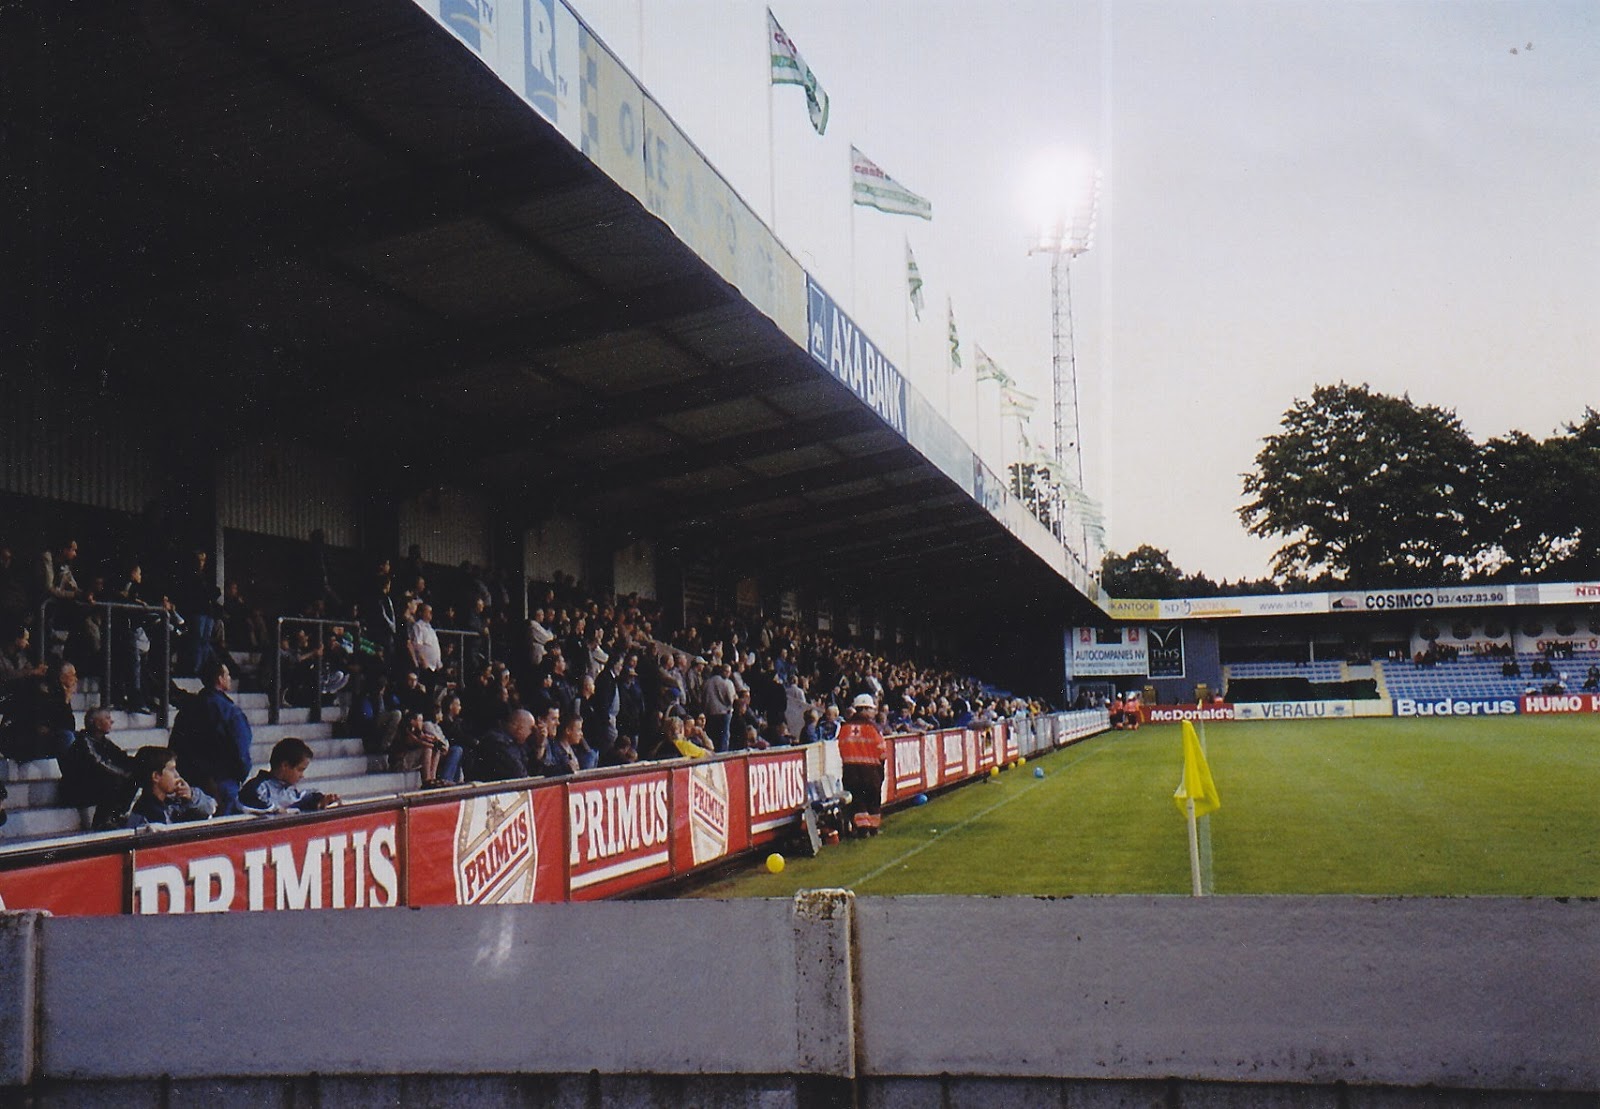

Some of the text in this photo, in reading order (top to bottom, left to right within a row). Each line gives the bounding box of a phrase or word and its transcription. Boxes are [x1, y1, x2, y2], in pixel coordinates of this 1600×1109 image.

[830, 307, 904, 433] AXA BANK
[1365, 593, 1434, 609] COSIMCO
[1075, 649, 1146, 660] AUTOCOMPANIES NV
[1152, 648, 1180, 659] THYS
[1261, 702, 1326, 718] VERALU
[1396, 699, 1516, 716] Buderus
[1525, 696, 1582, 712] HUMO
[1150, 708, 1234, 721] McDonald's
[749, 758, 805, 817] PRIMUS
[692, 779, 725, 832] PRIMUS
[569, 779, 669, 866] PRIMUS
[463, 809, 529, 904] PRIMUS
